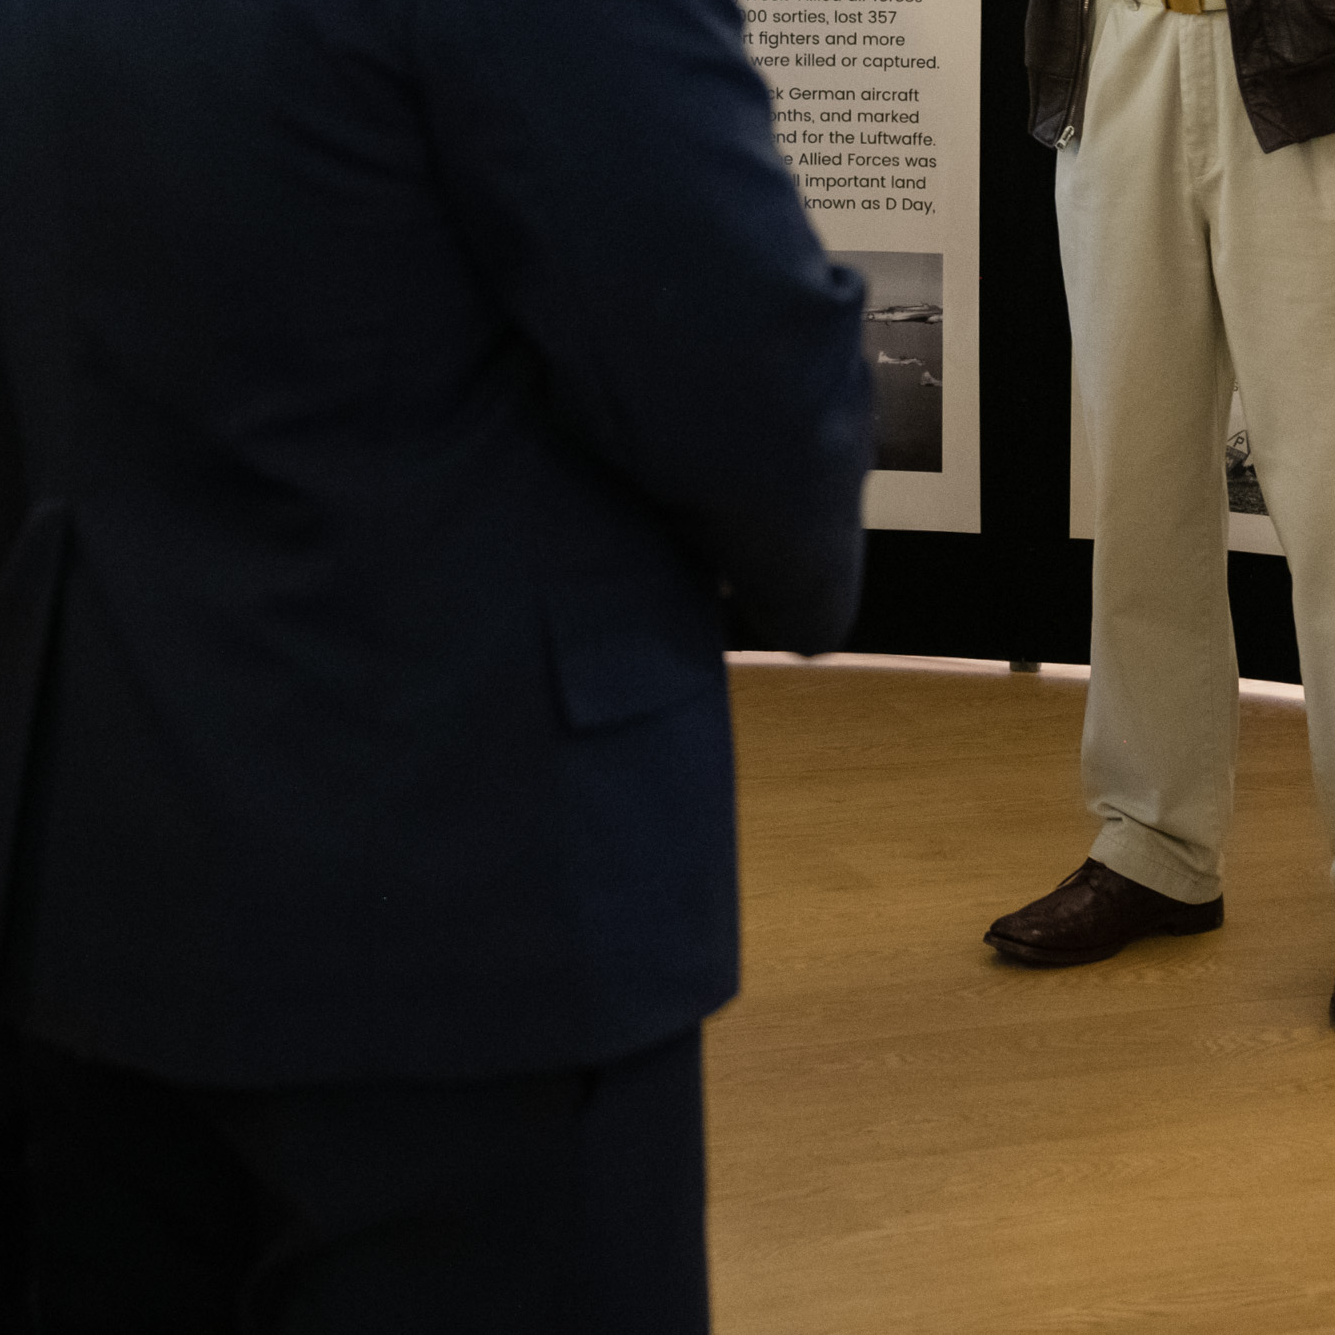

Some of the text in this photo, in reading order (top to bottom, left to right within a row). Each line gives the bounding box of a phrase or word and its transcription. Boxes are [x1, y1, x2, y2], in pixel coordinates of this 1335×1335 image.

[773, 10, 897, 25] sorties, lost 357
[755, 53, 939, 71] were killed or captured.
[805, 196, 935, 215] known as D Day,
